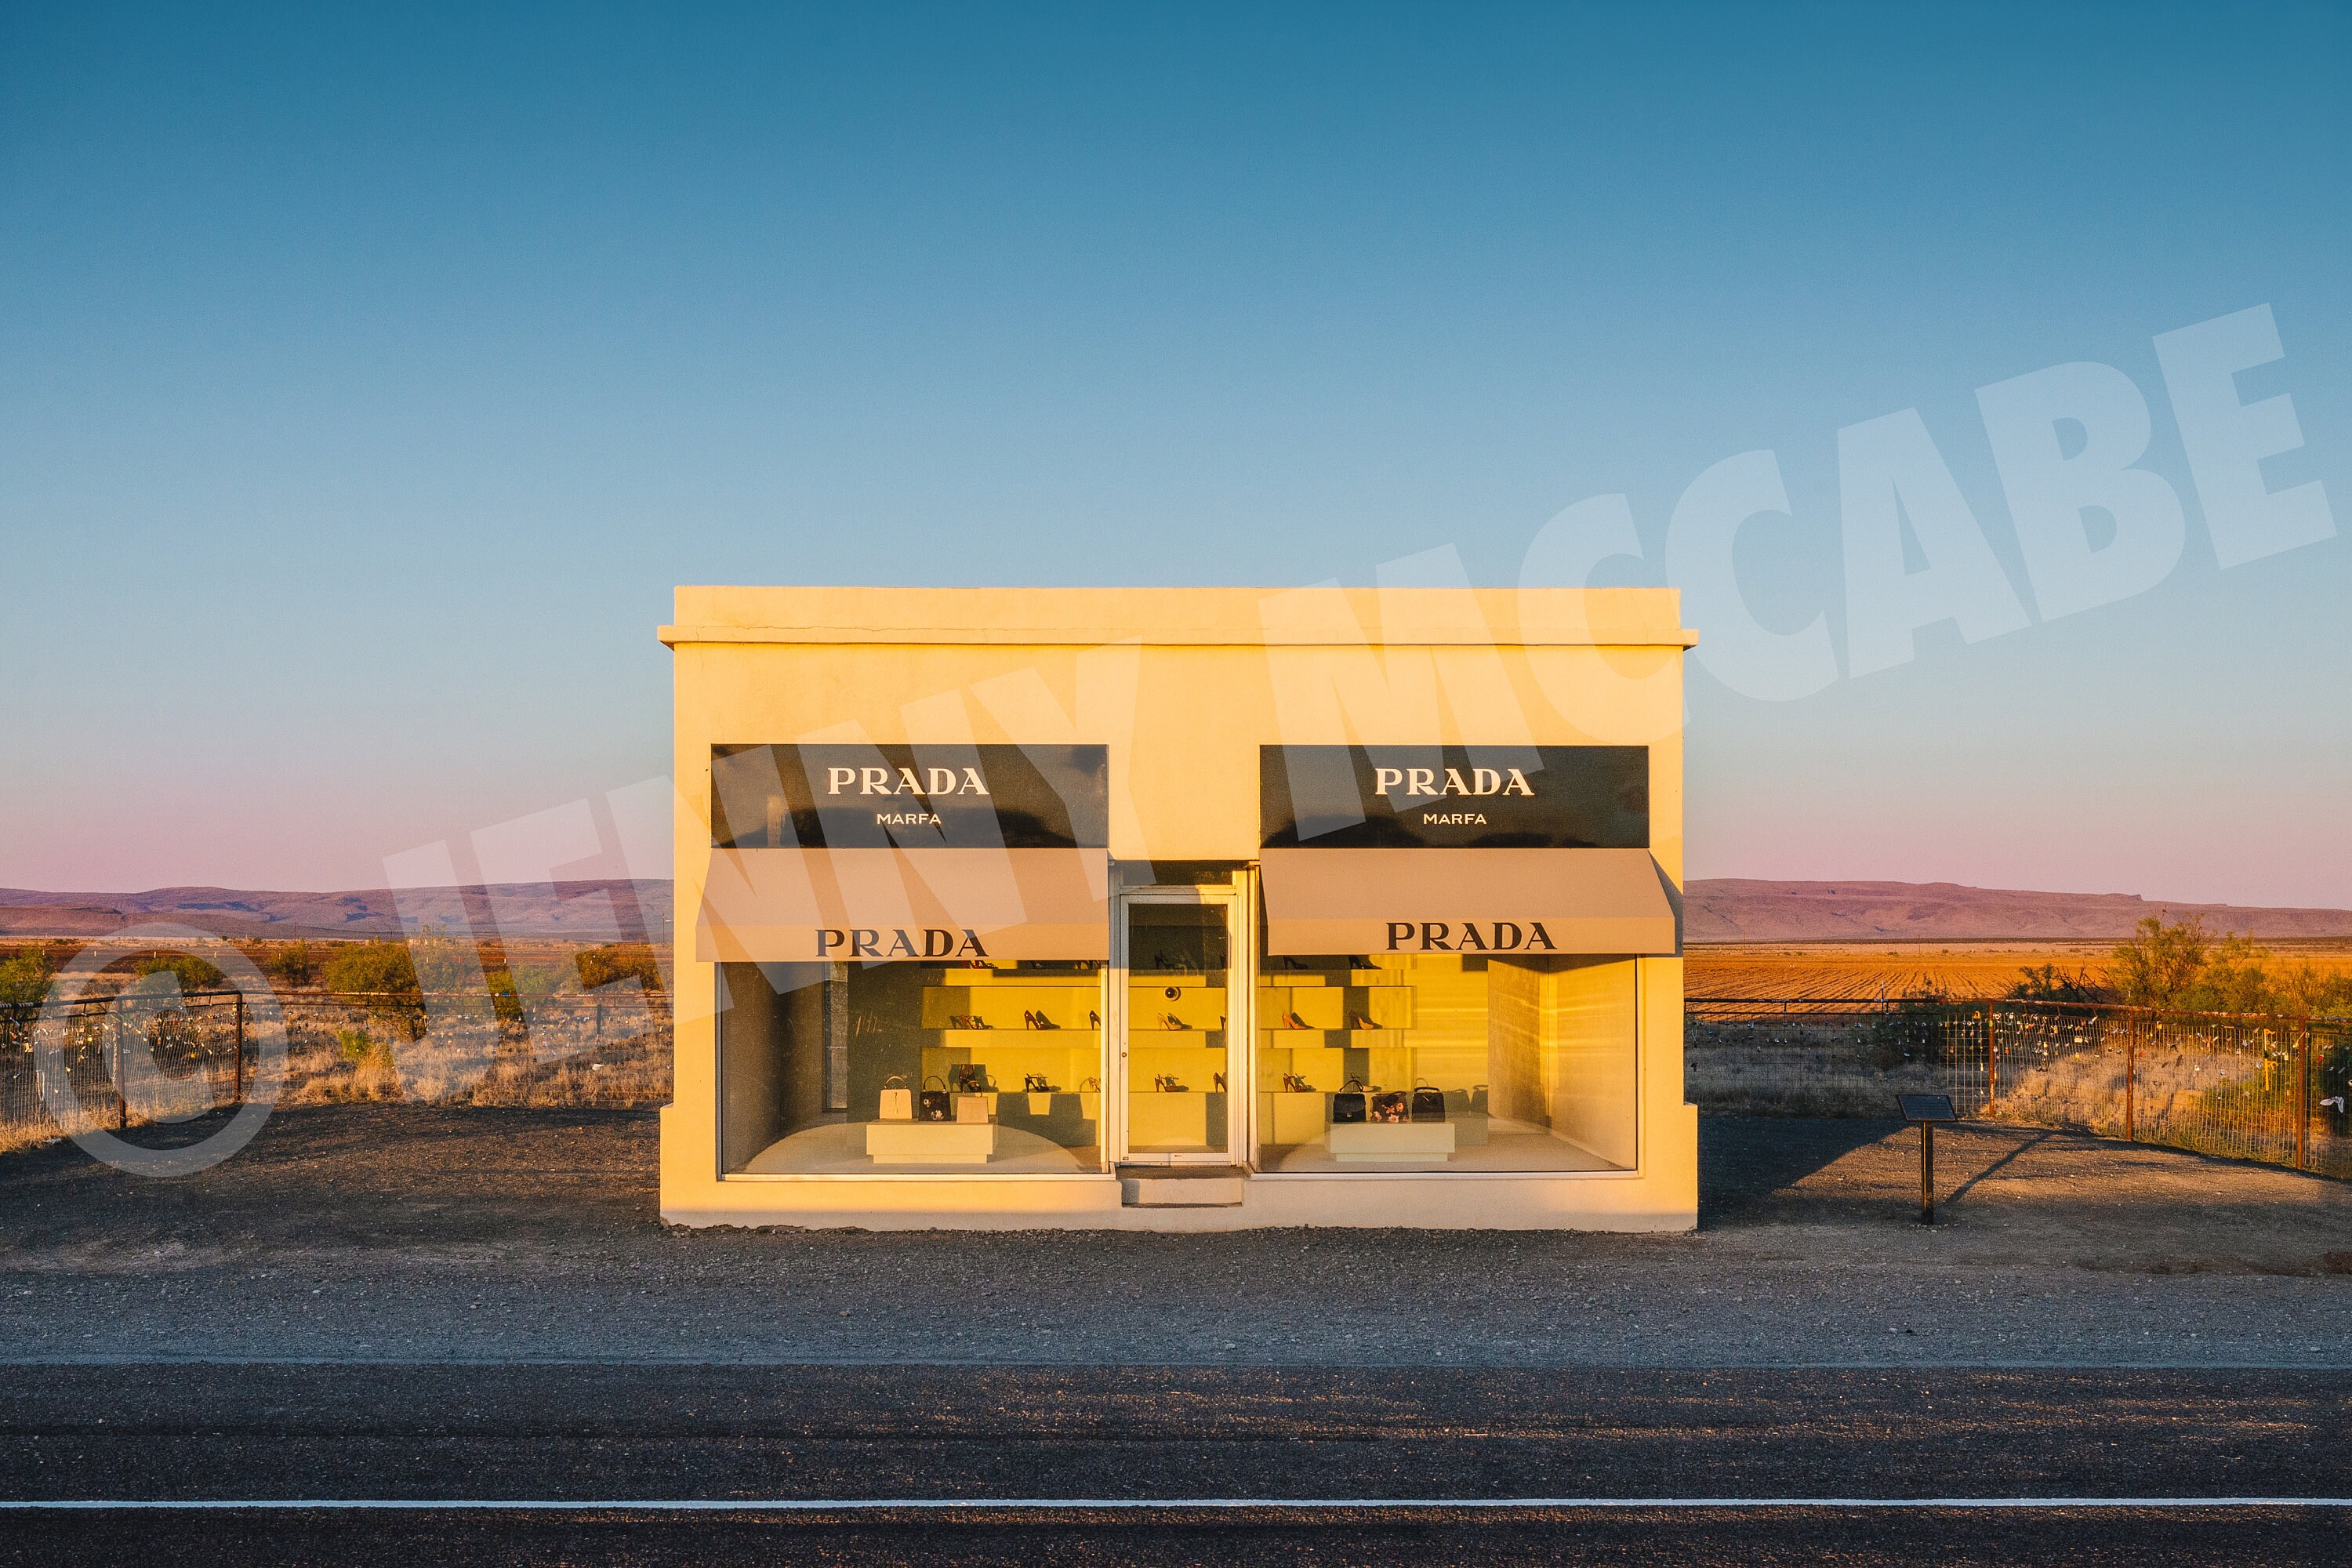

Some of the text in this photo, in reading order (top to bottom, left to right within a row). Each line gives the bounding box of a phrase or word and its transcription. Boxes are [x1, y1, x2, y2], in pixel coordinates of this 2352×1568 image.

[827, 767, 990, 795] PRADA
[1374, 768, 1535, 796] PRADA
[876, 813, 942, 825] MARFA
[1423, 813, 1487, 825] MARFA
[815, 928, 989, 958] PRADA
[1385, 922, 1558, 951] PRADA
